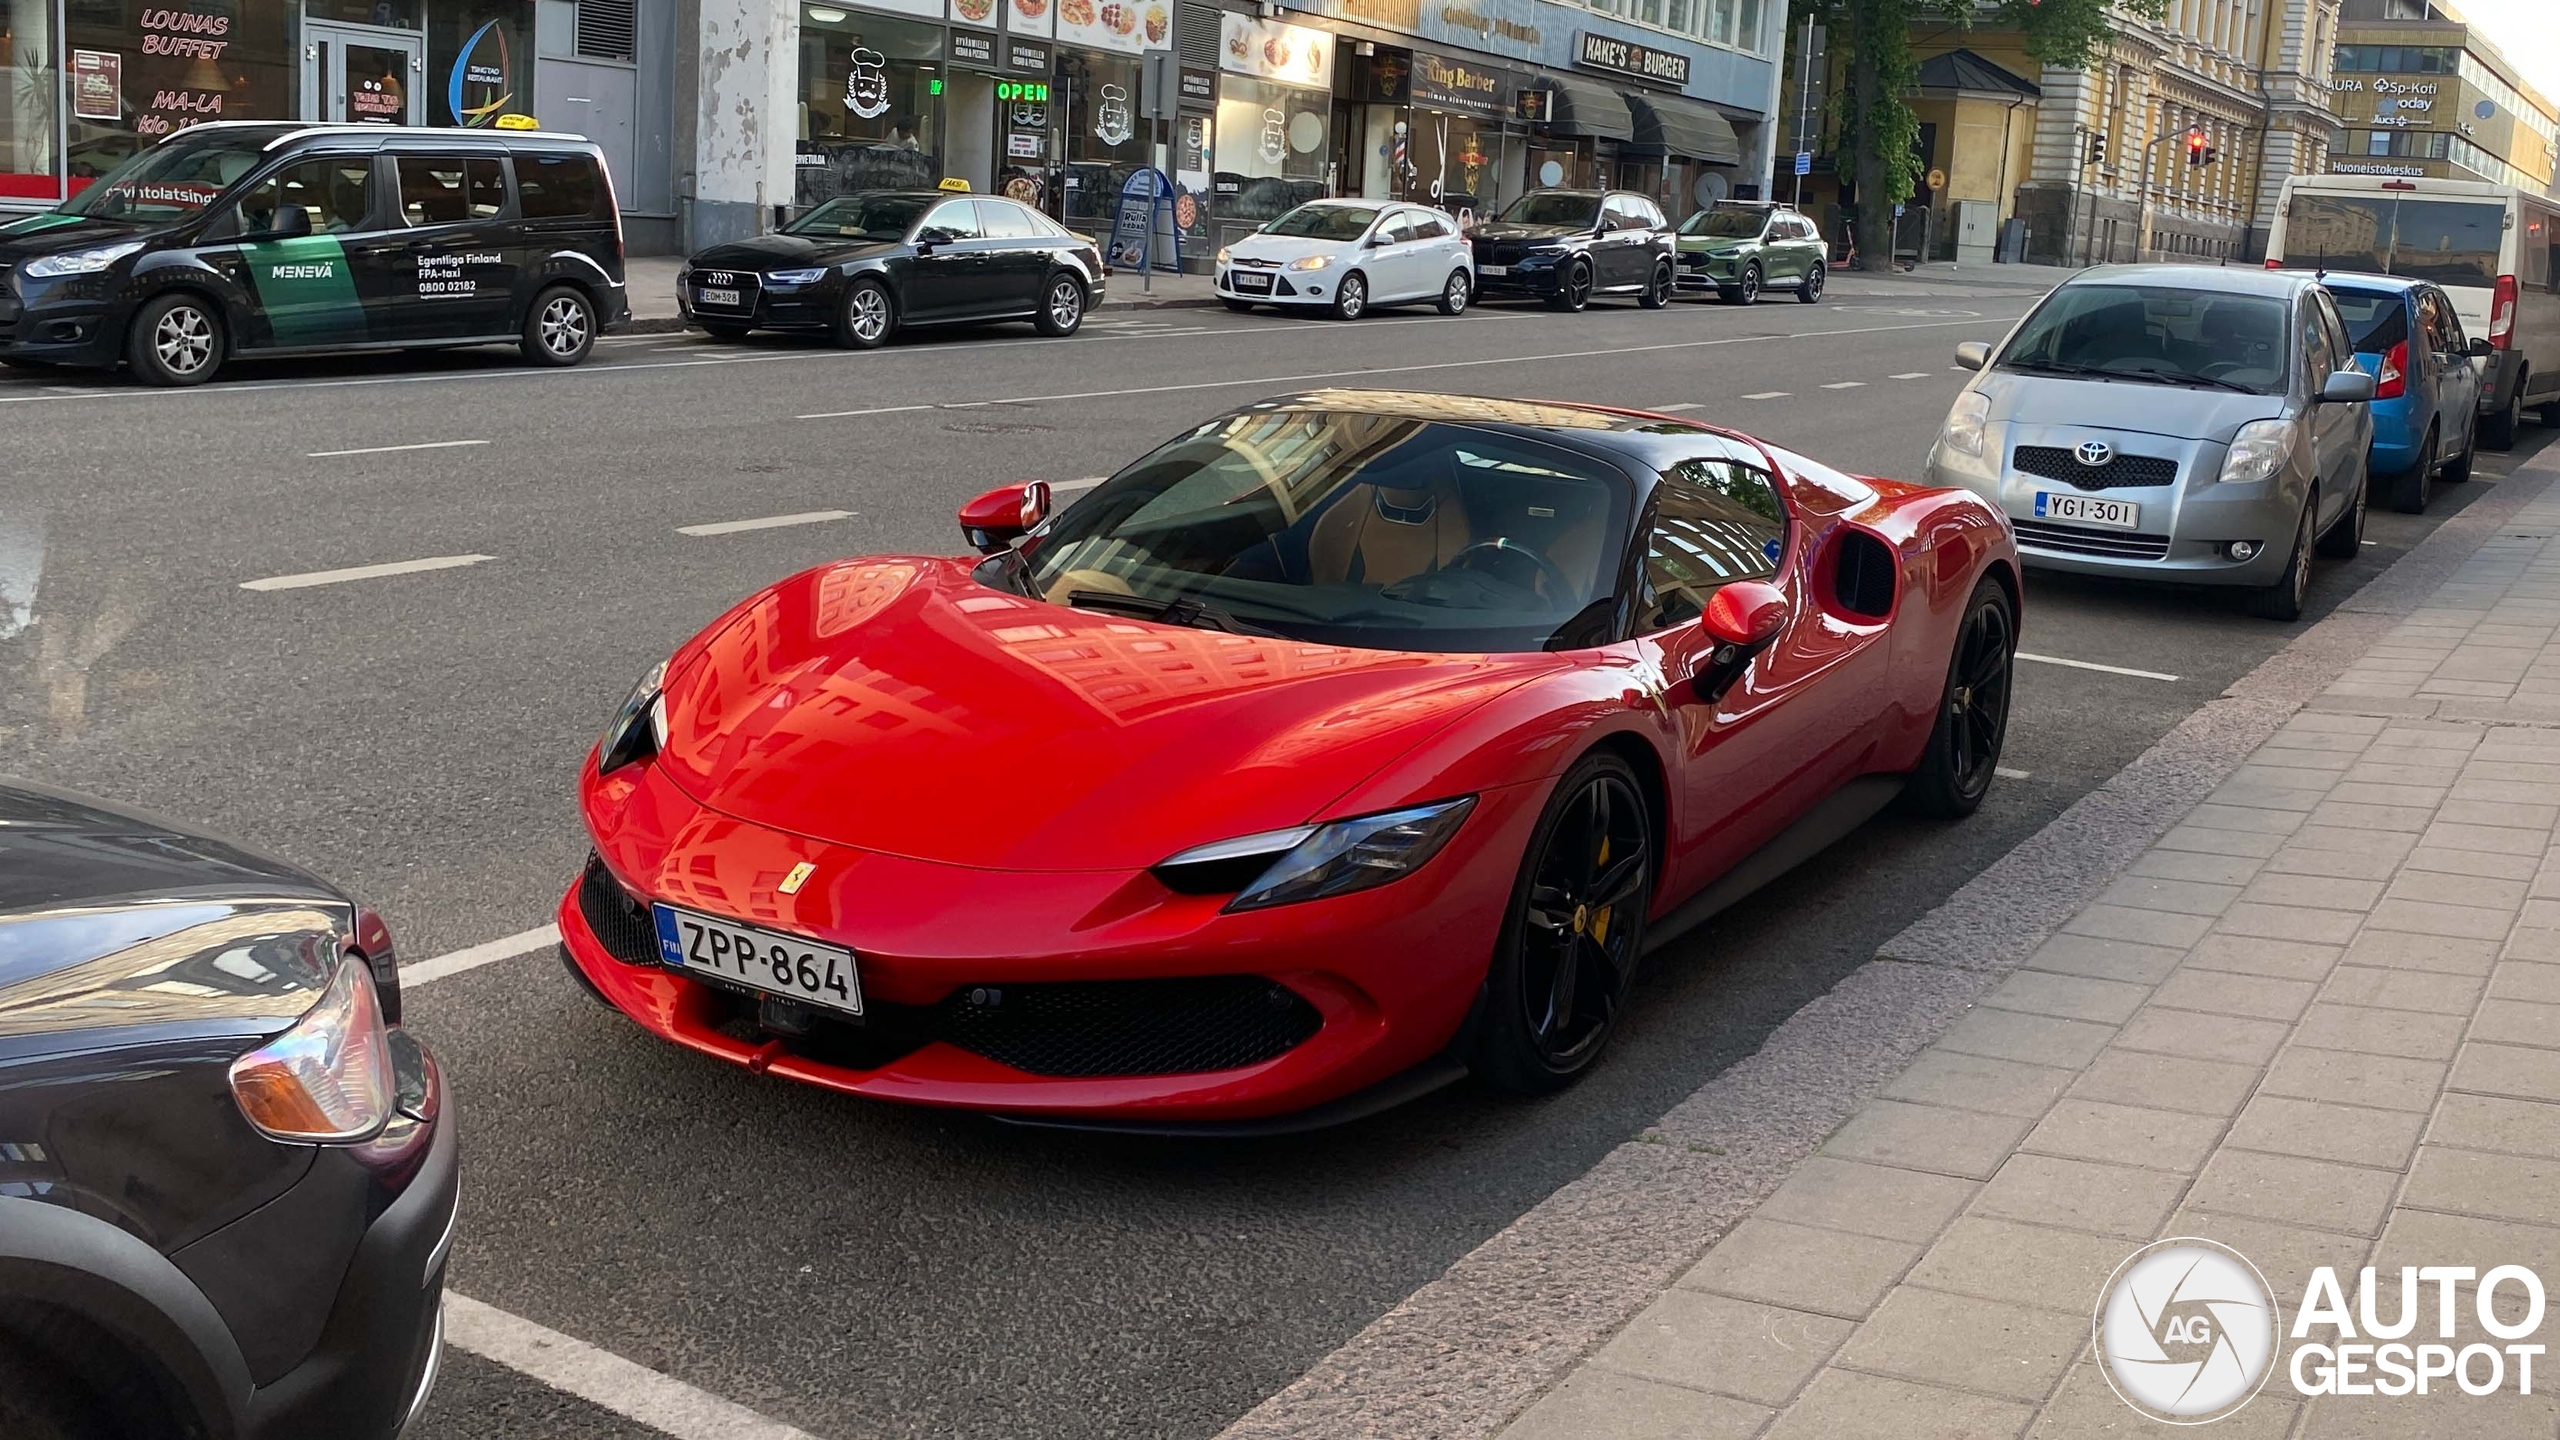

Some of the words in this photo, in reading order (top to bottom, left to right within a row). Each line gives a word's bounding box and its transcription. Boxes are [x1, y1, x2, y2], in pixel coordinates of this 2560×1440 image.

[141, 9, 228, 35] LOUNAS
[142, 35, 227, 60] BUFFET
[1586, 36, 1627, 67] KAKE'S
[1643, 51, 1685, 80] BURGER
[1427, 60, 1454, 89] King
[1456, 68, 1495, 92] Barber
[998, 83, 1047, 101] OPEN
[2390, 82, 2438, 96] Sp-Koti
[152, 91, 221, 113] MA-LA
[2332, 161, 2424, 176] Huoneistokeskus
[1124, 212, 1147, 222] Rulla
[1122, 222, 1146, 231] kebab
[417, 255, 464, 268] Egentliga
[466, 253, 501, 264] Finland
[272, 261, 333, 279] MENEVÄ
[418, 267, 461, 279] FPA-taxi
[419, 282, 445, 292] 0800
[447, 280, 476, 291] 02182
[2052, 497, 2128, 523] YGI-301
[663, 939, 681, 955] FIN
[683, 921, 848, 1000] ZPP-864
